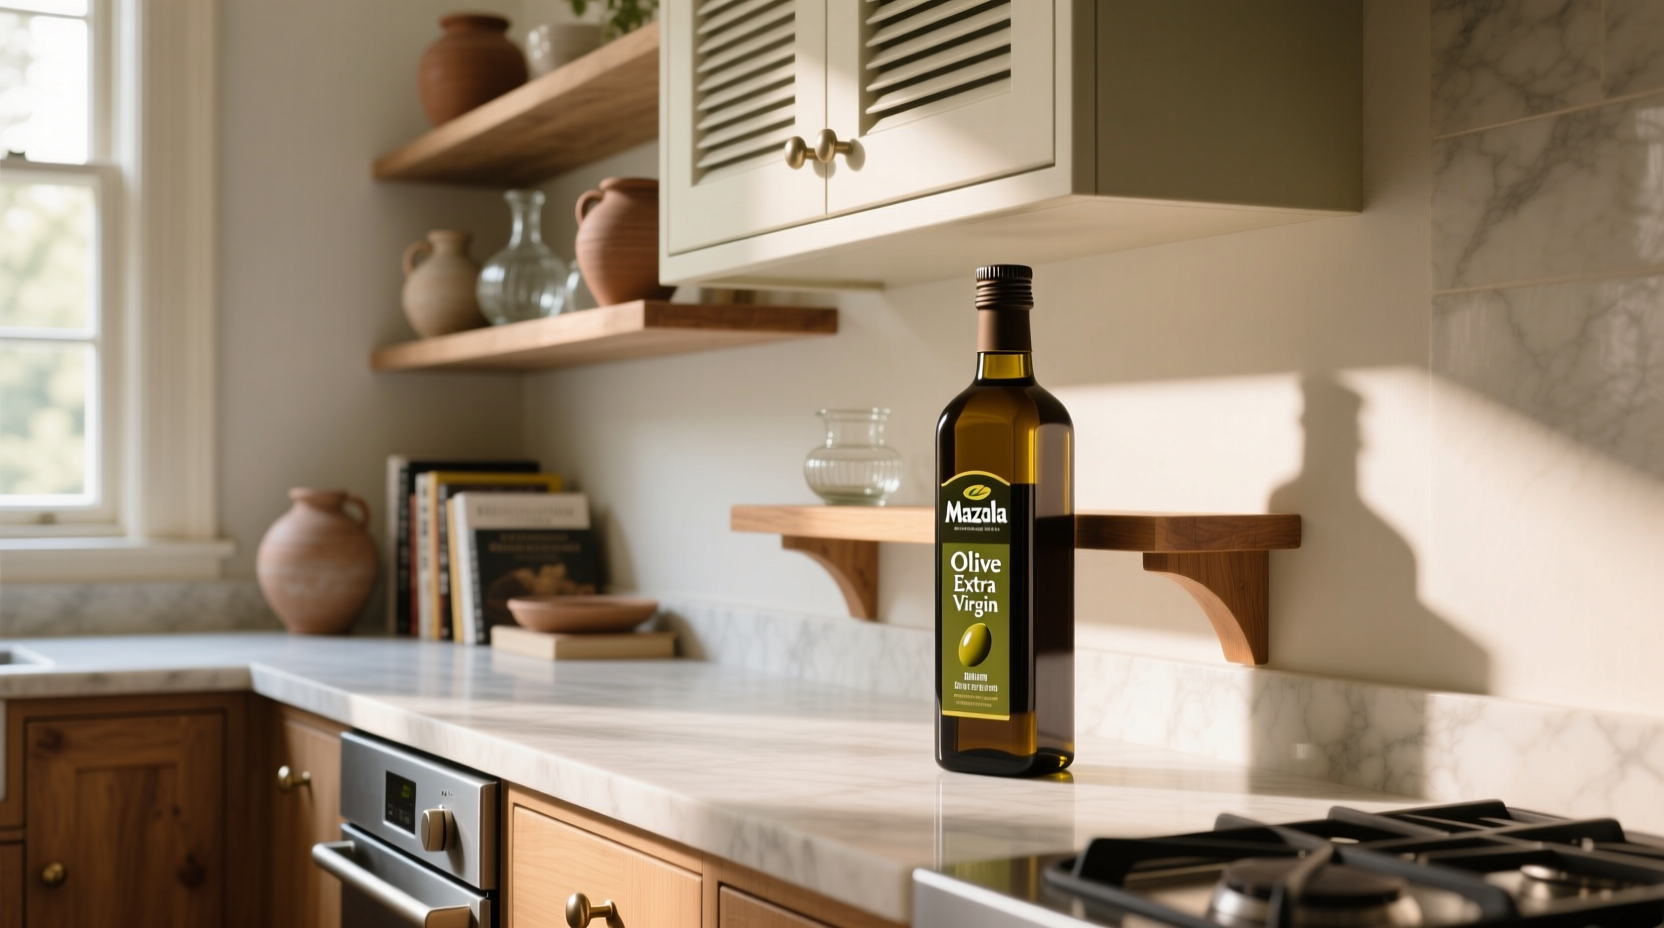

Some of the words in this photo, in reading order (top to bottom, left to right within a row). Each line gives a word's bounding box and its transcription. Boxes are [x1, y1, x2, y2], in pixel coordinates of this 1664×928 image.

[945, 500, 1008, 524] Mazola
[951, 551, 1002, 573] Olive
[954, 574, 996, 593] Extra
[953, 595, 998, 618] Virgin
